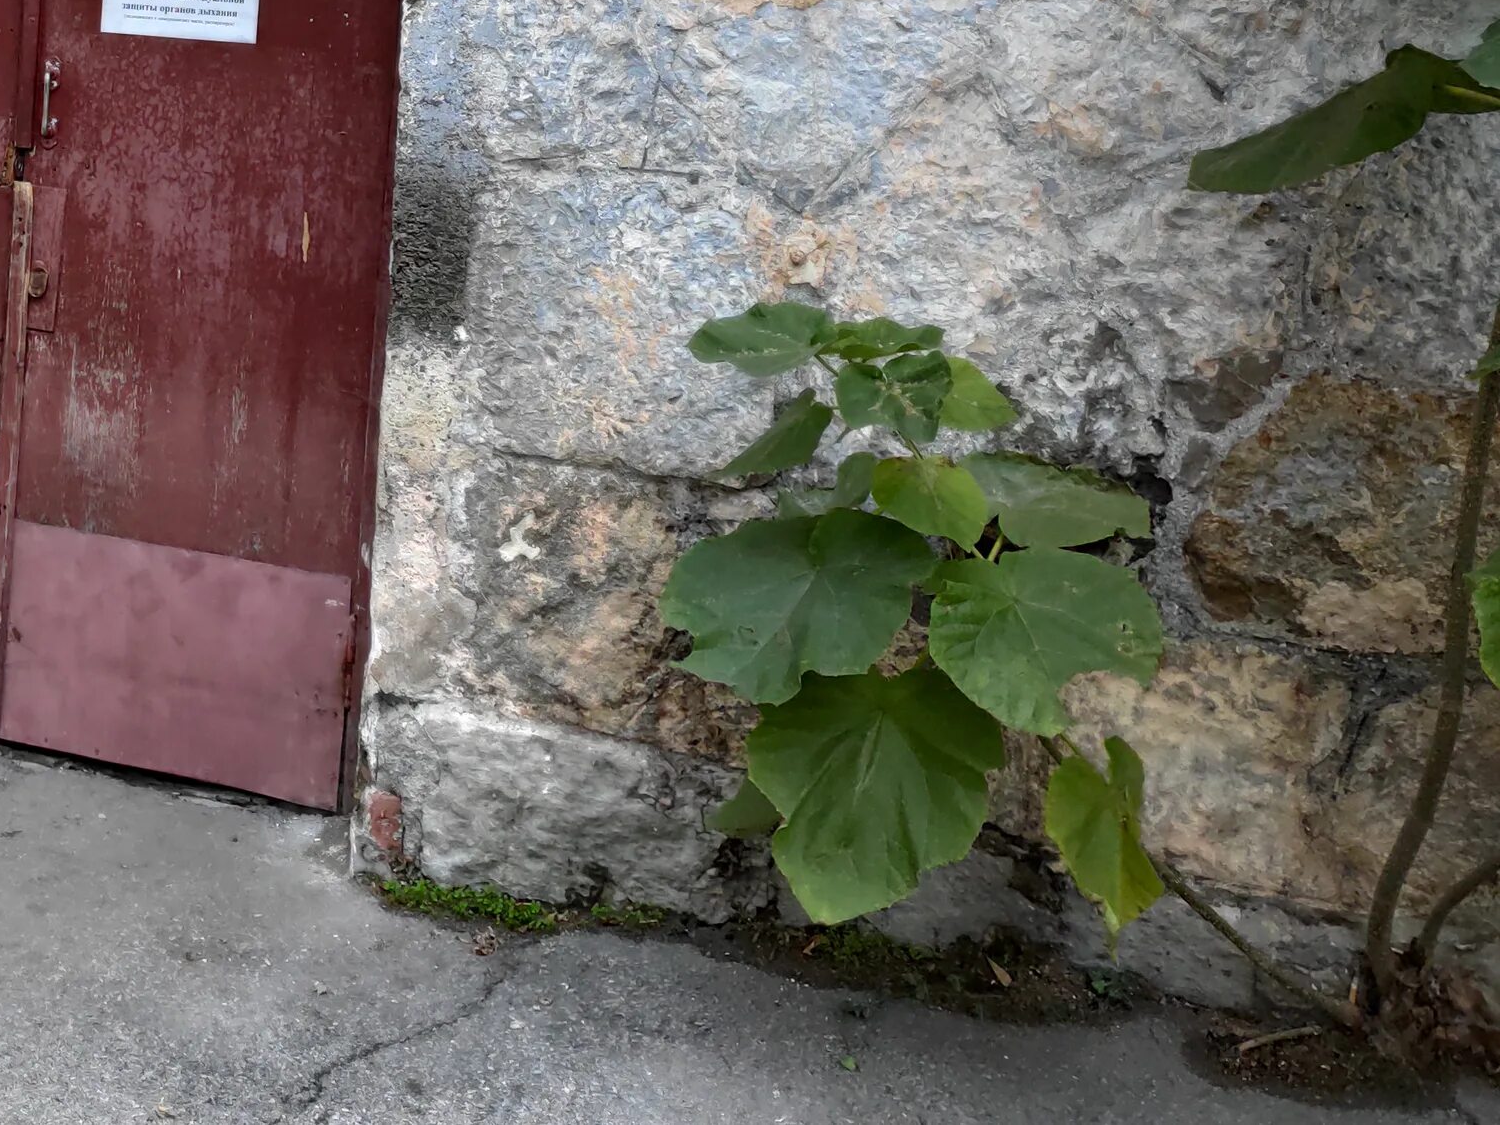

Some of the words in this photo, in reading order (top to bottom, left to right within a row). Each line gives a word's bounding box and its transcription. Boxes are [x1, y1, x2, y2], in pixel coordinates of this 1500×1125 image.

[122, 3, 158, 13] защиты
[160, 5, 196, 16] органов
[198, 8, 238, 19] дыхания
